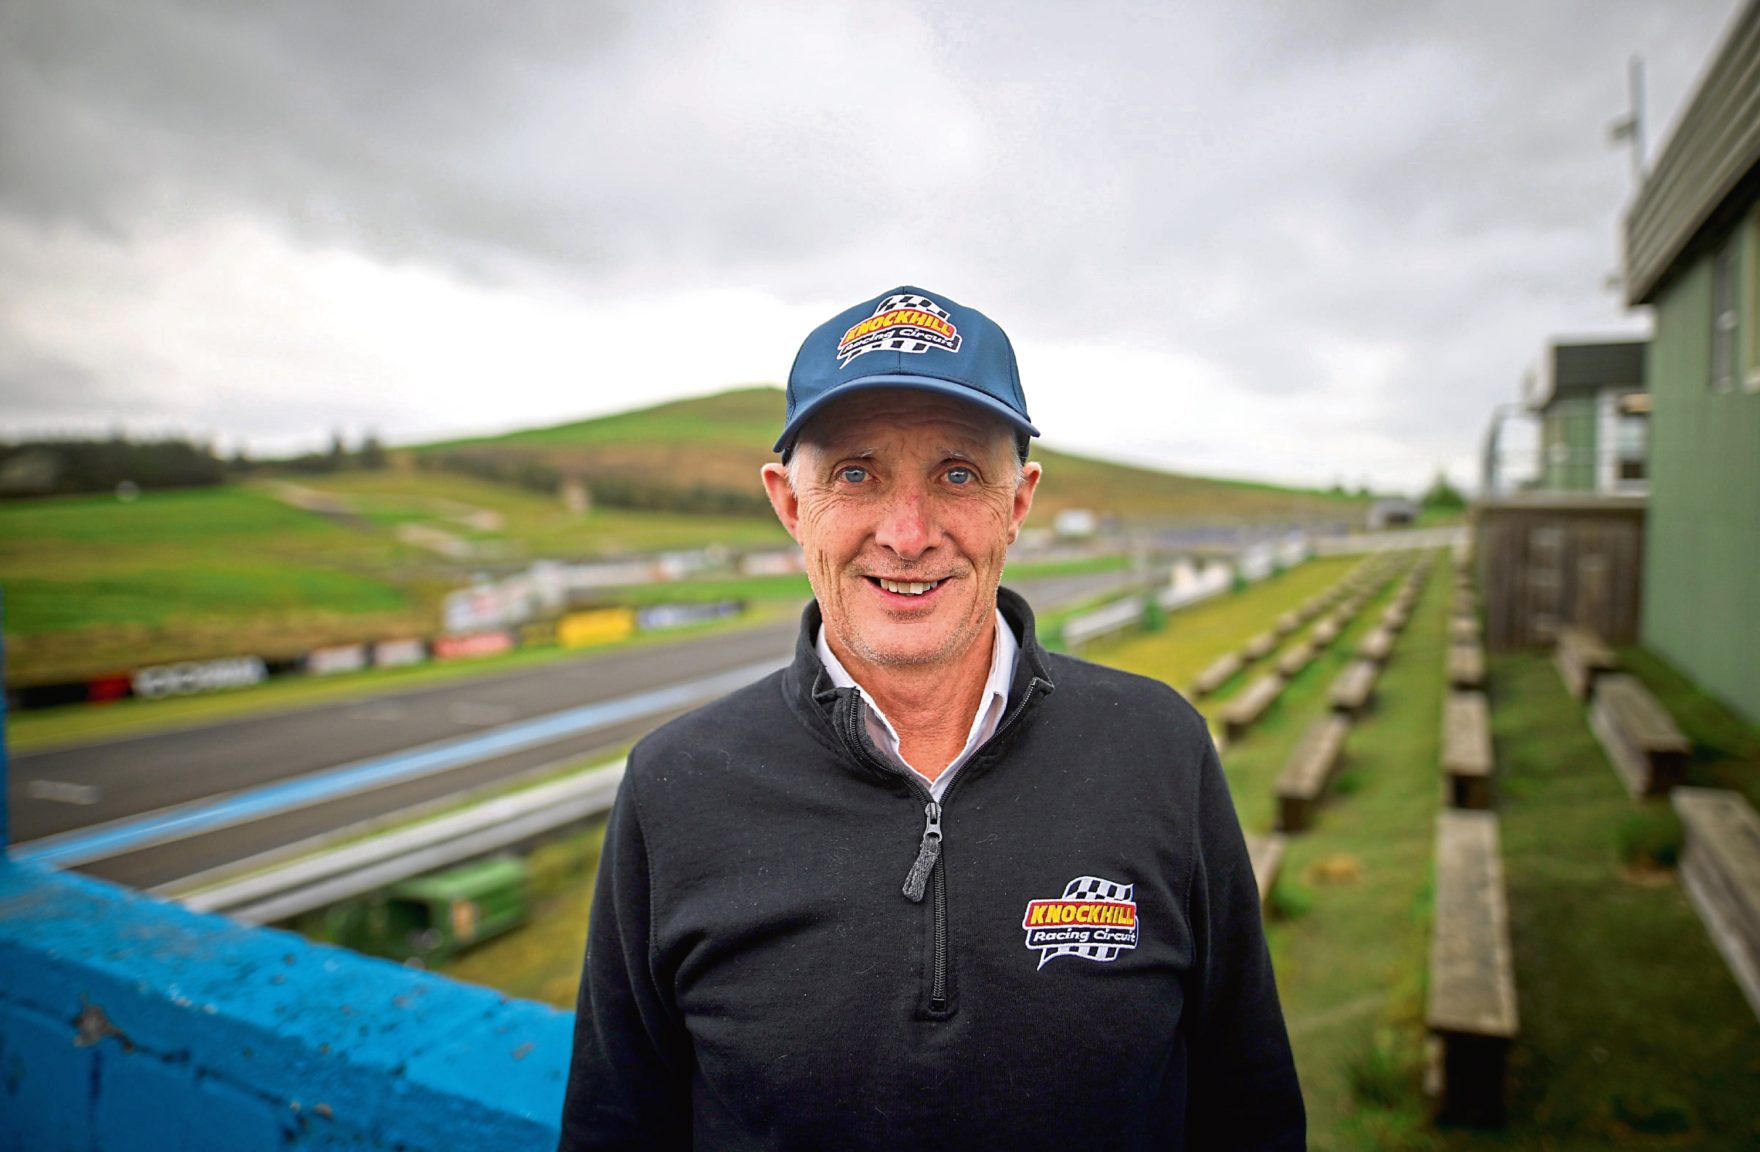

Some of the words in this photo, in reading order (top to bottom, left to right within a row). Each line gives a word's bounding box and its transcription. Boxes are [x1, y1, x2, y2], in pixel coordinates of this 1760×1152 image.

[845, 310, 952, 341] KNOCKHILL
[845, 329, 894, 350] Racing
[899, 328, 954, 347] Circuit
[1030, 905, 1134, 925] KNOCKHILL
[1033, 928, 1090, 943] Racing
[1093, 928, 1136, 942] Circuit
